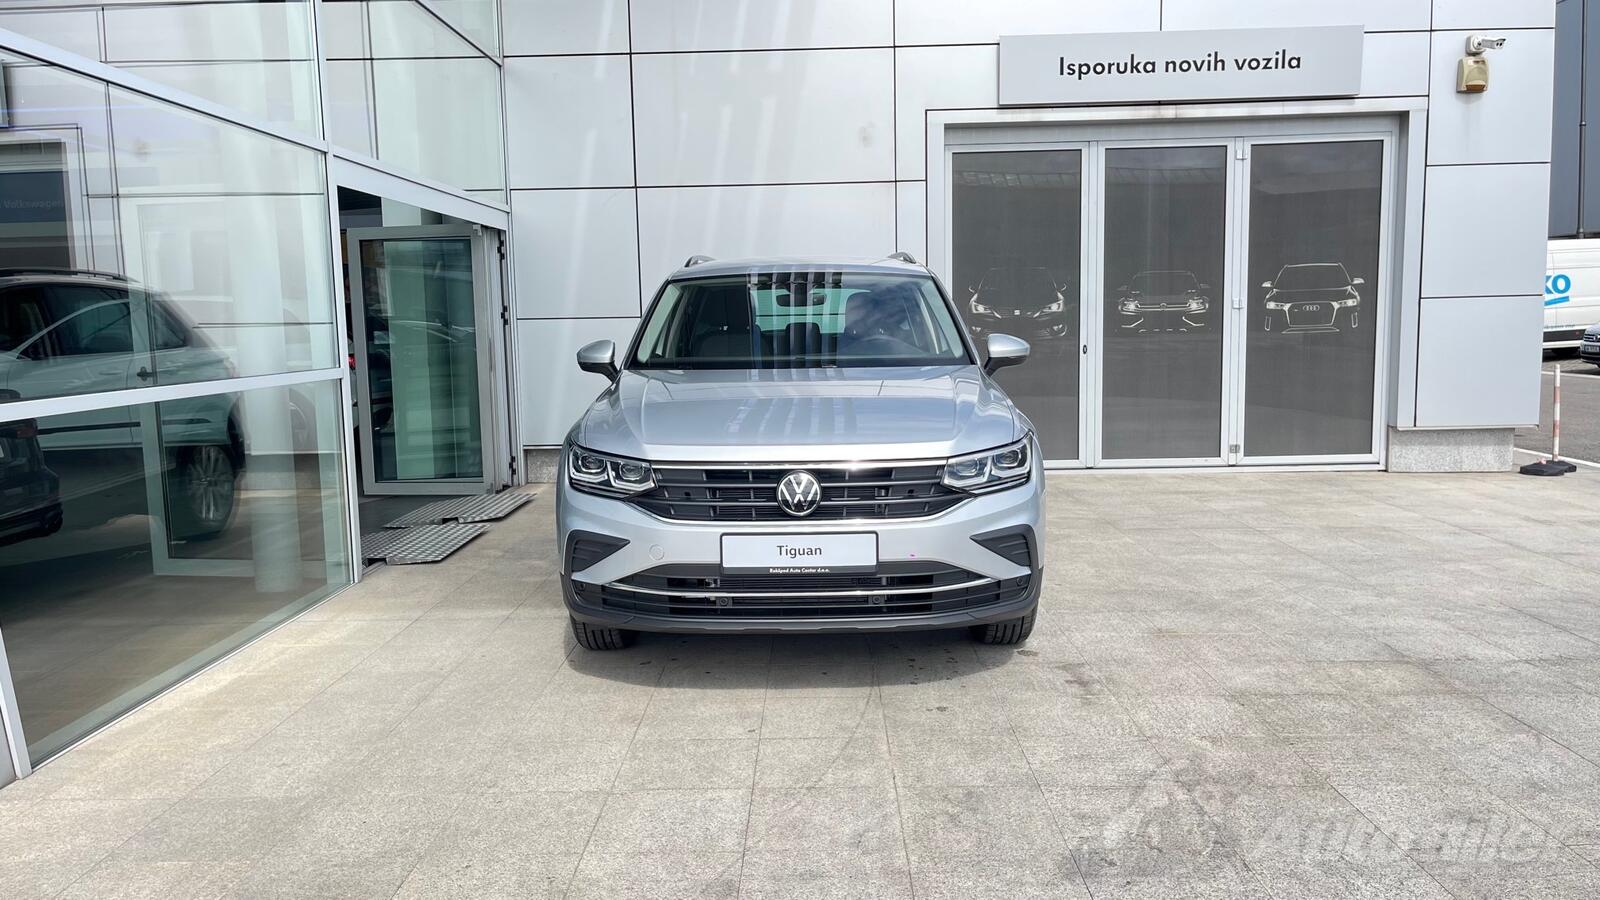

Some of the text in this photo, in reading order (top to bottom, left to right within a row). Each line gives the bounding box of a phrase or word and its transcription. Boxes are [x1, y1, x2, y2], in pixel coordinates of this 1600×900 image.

[1059, 48, 1301, 80] Isporuka novih vozila
[776, 544, 822, 559] Tiguan
